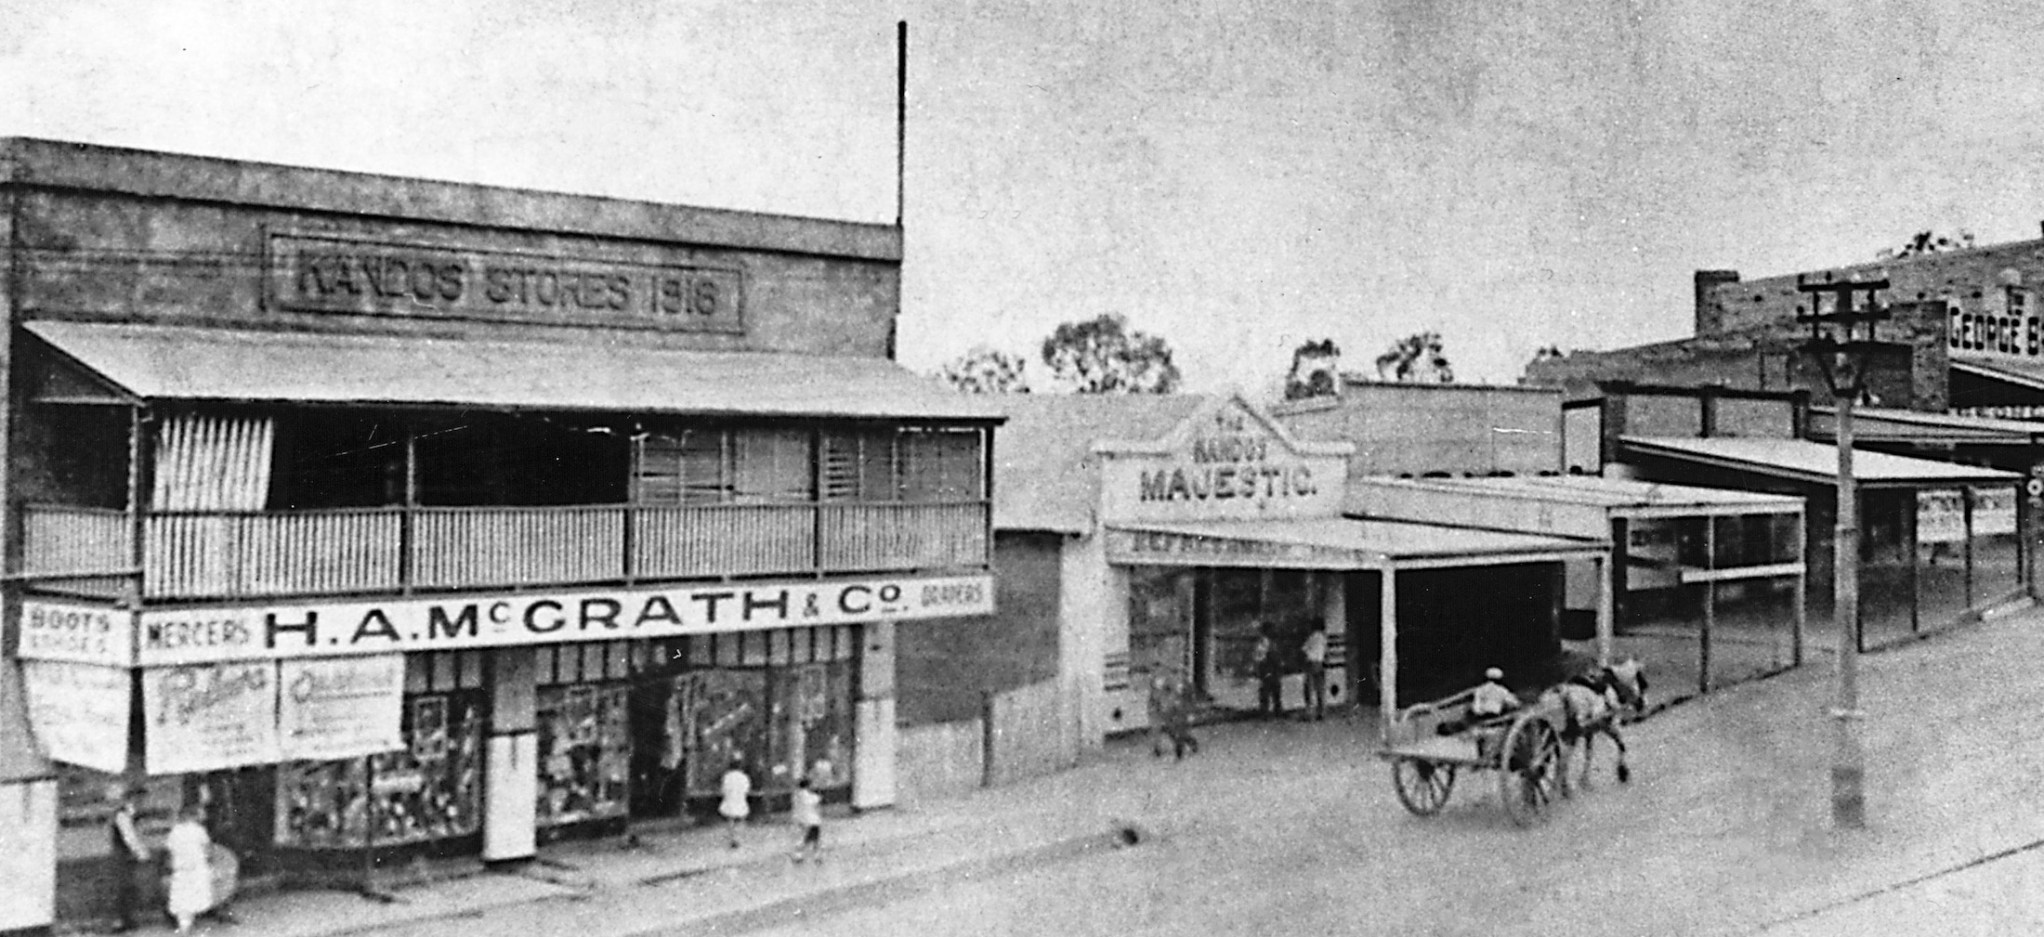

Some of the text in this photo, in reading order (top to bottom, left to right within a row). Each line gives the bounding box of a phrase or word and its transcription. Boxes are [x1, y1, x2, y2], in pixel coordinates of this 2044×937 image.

[297, 250, 463, 302] KANDOS
[486, 268, 630, 311] STORES
[1949, 306, 2021, 354] GEORGE
[30, 606, 110, 633] BOOTS
[803, 592, 820, 618] &
[147, 619, 249, 651] MERCERS
